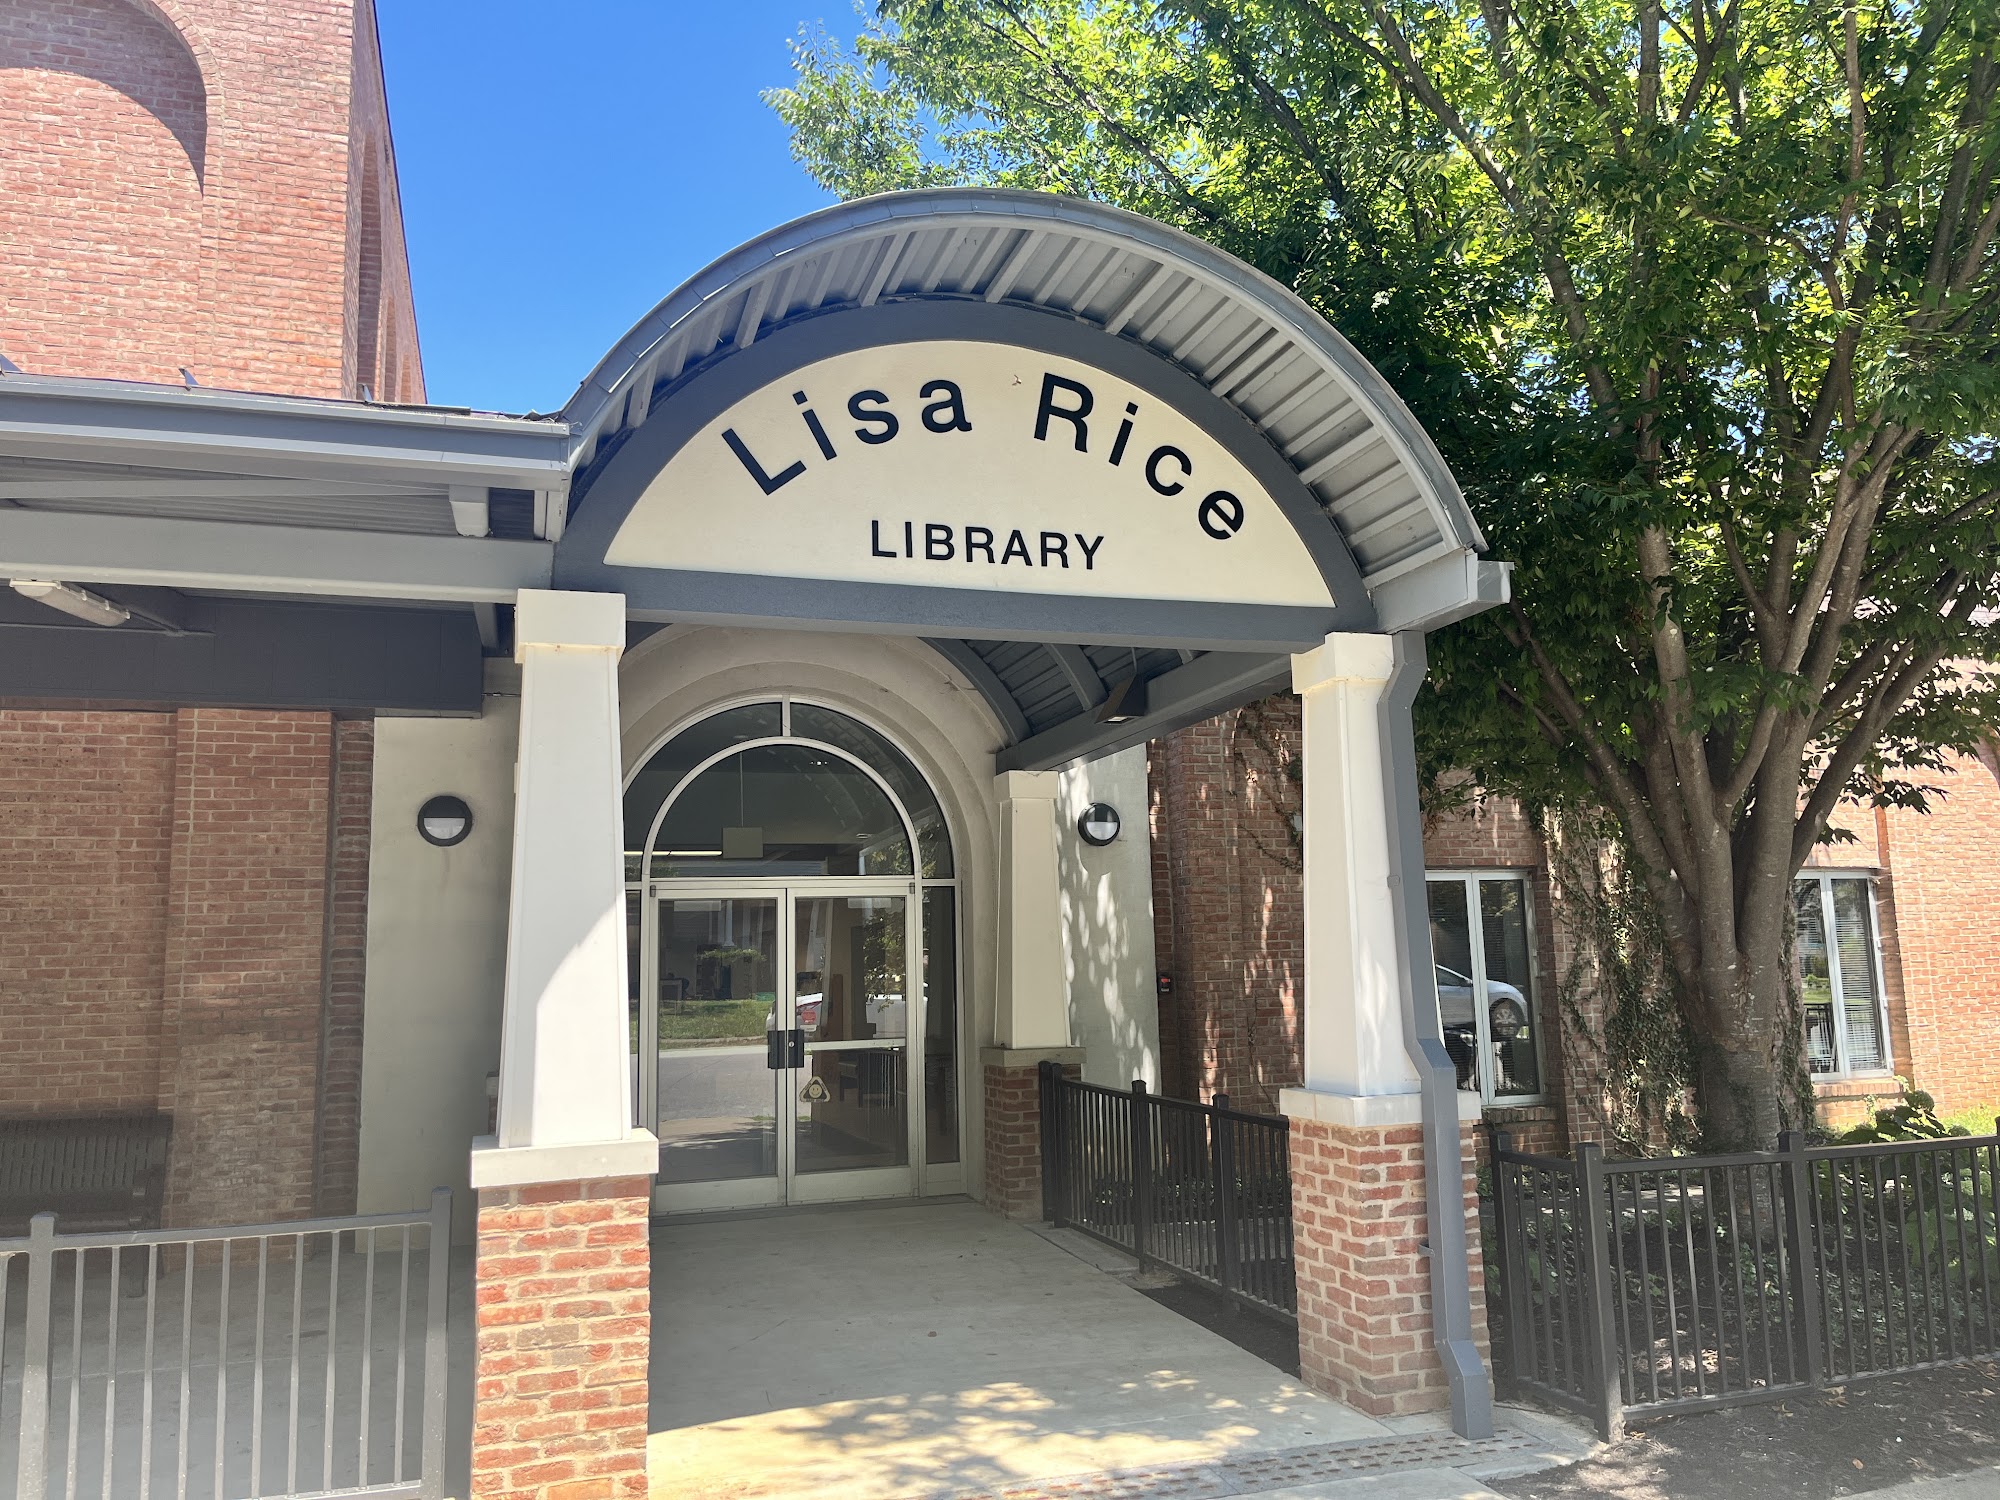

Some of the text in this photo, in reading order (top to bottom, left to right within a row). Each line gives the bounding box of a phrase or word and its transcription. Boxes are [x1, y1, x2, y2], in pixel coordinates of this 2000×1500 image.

[722, 371, 1244, 540] Lisa Rice
[871, 519, 1104, 570] LIBRARY
